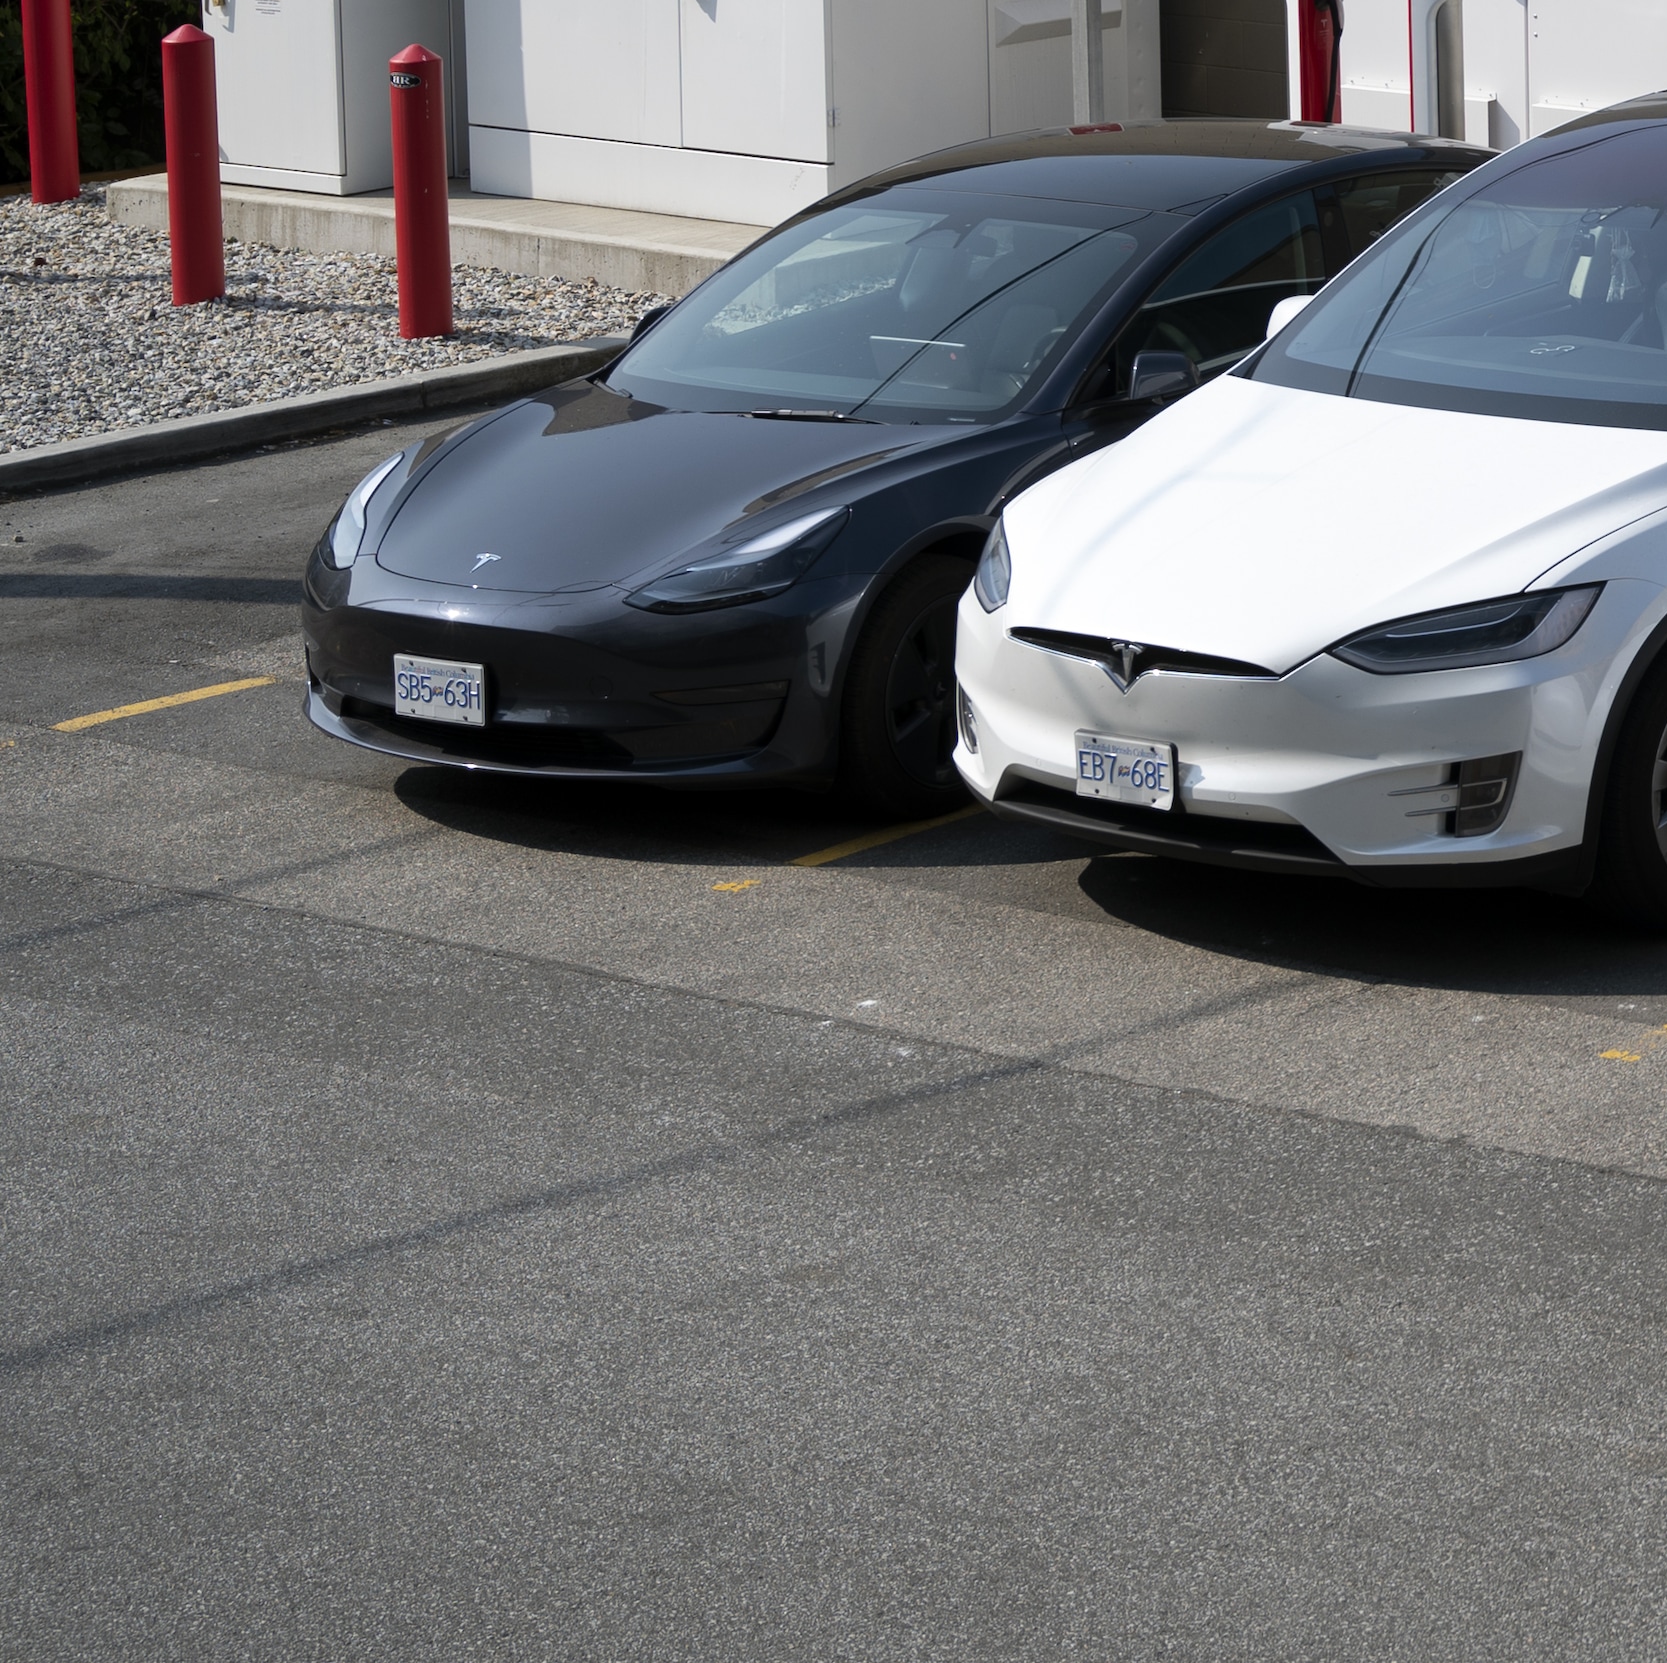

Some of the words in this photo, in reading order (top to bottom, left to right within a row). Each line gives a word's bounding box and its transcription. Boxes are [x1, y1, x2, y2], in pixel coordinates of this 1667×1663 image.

[397, 672, 433, 703] SB5
[444, 679, 480, 710] 63H
[1079, 749, 1117, 784] EB7
[1130, 757, 1170, 793] 68E
